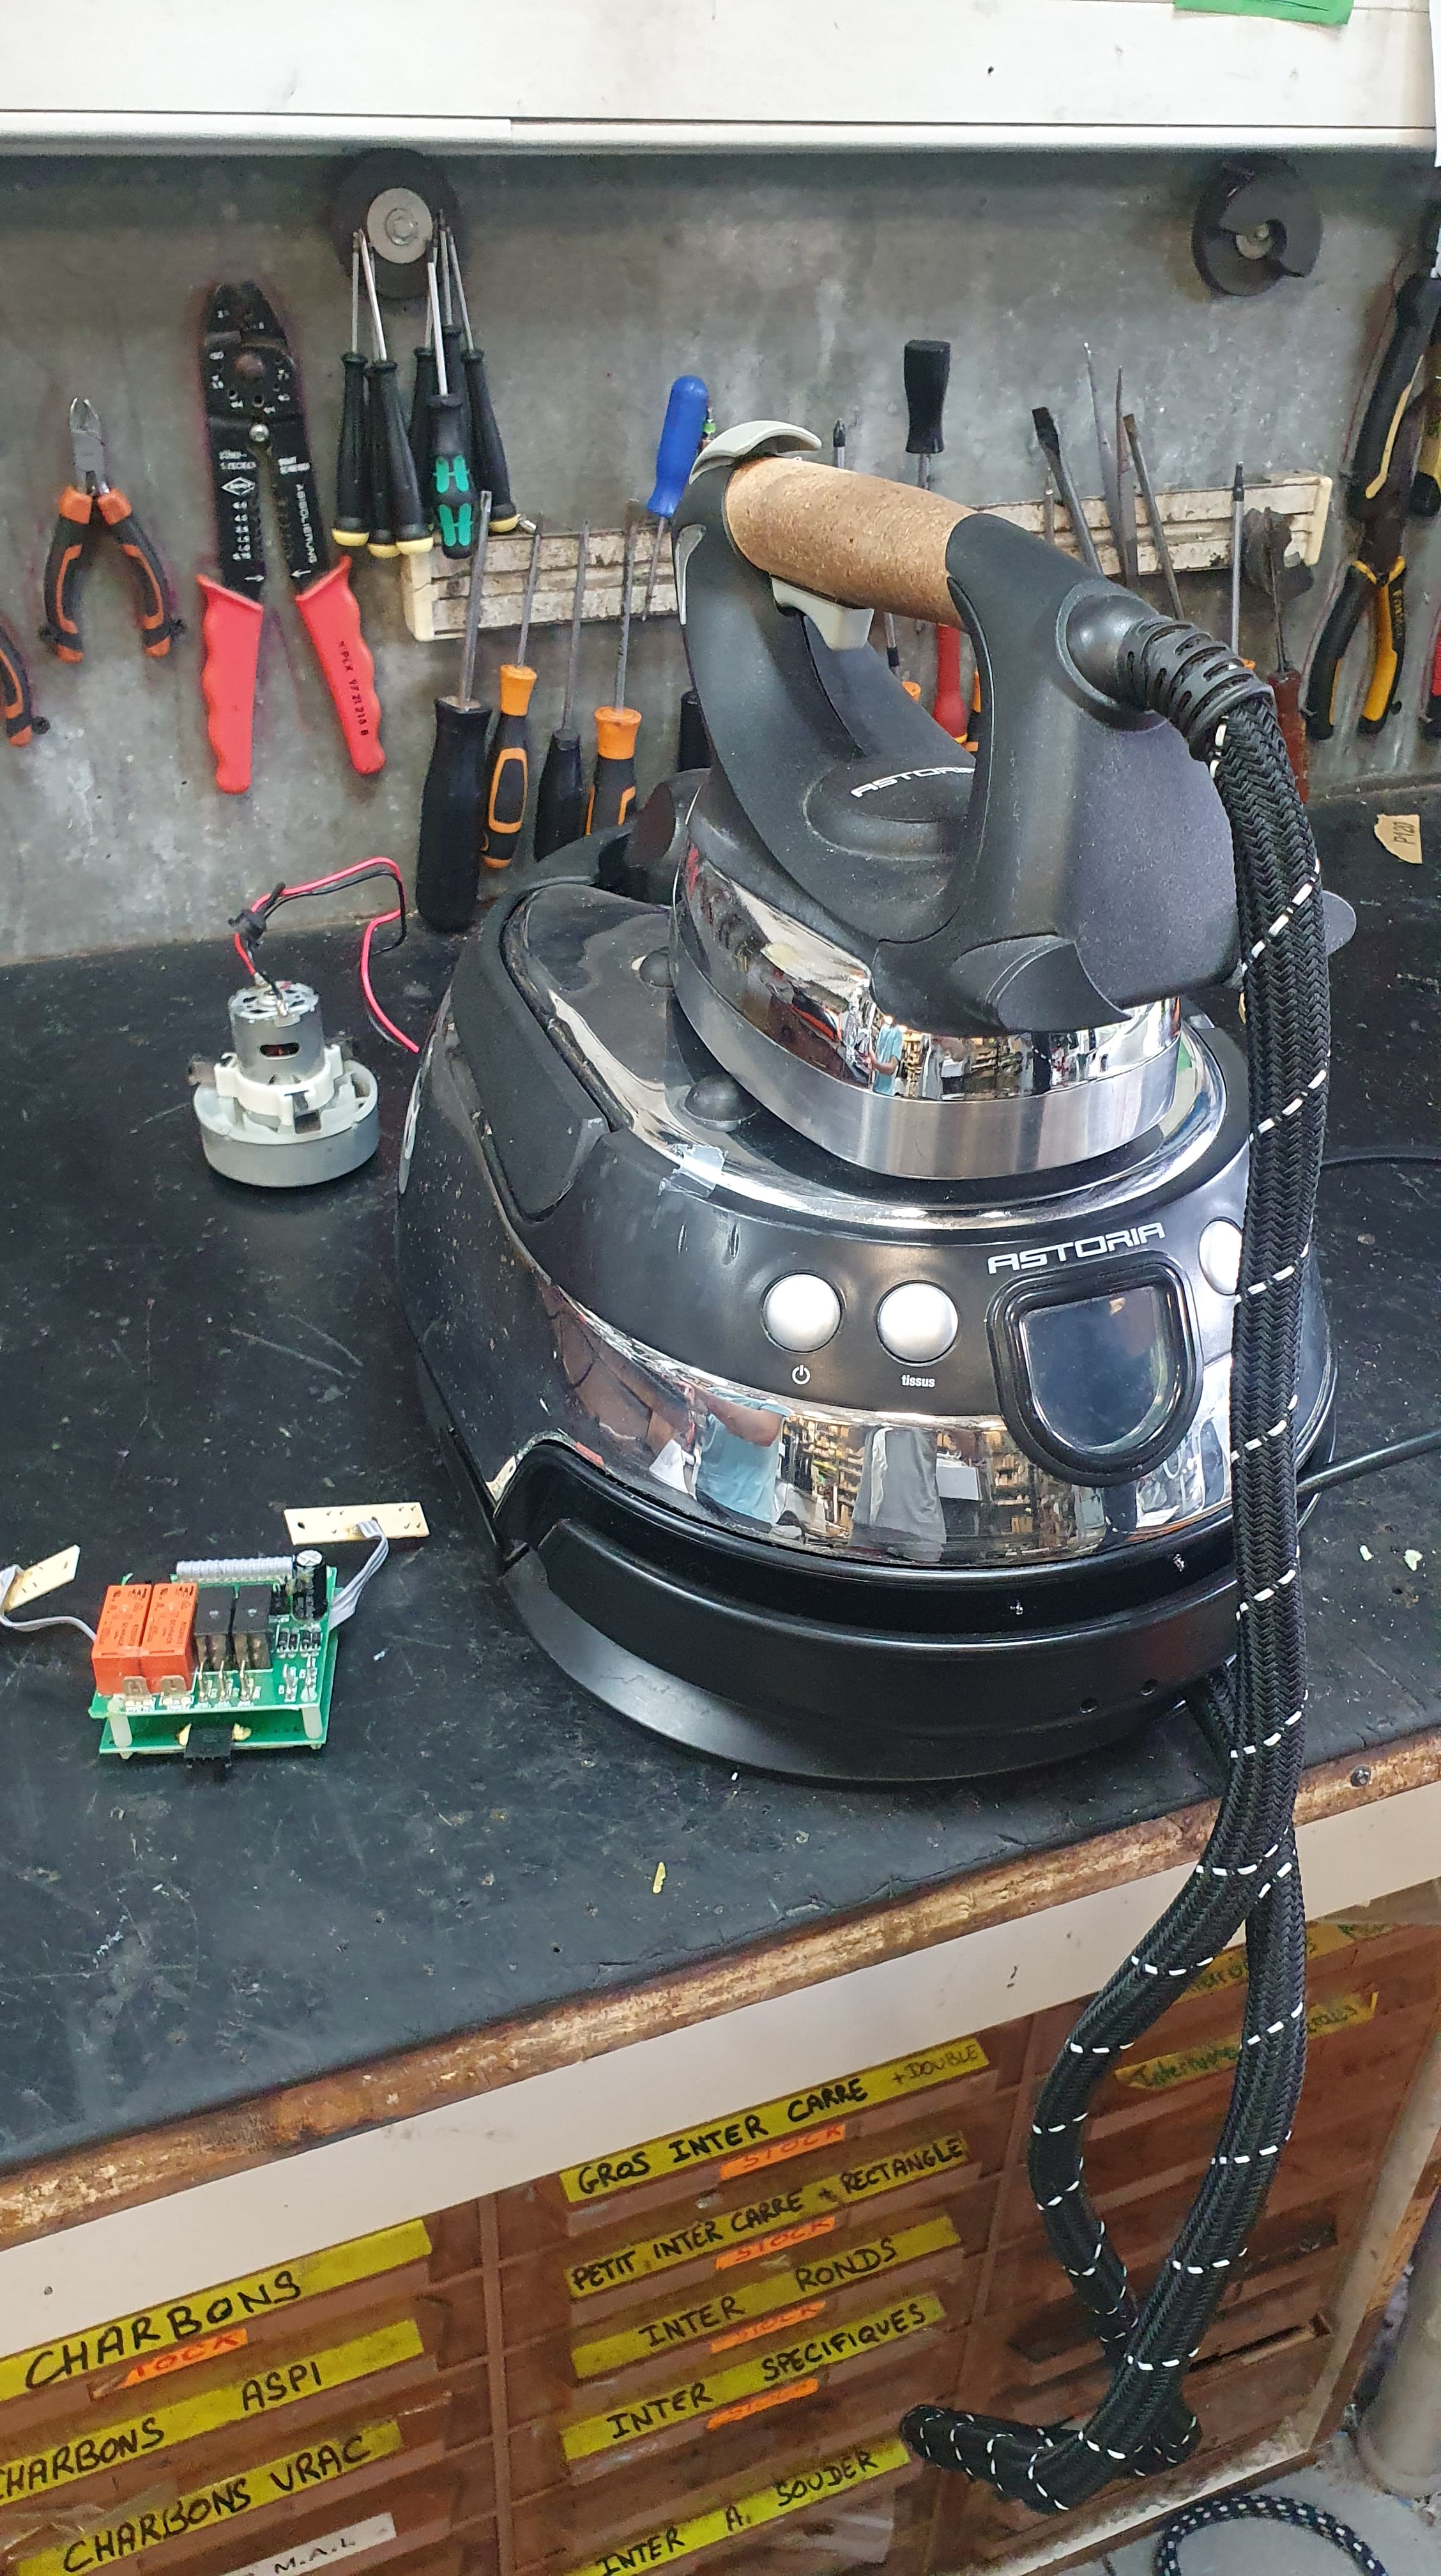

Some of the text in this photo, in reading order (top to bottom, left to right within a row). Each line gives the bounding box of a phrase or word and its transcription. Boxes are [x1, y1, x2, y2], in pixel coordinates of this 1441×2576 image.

[987, 1222, 1166, 1275] ASTORIA
[901, 1374, 936, 1388] tissus
[577, 2150, 652, 2195] GROS
[668, 2115, 769, 2164] INTER
[786, 2078, 869, 2122] CARRE
[572, 2250, 636, 2291] PETIT
[652, 2220, 724, 2260] INTER
[730, 2188, 805, 2233] CARRE
[840, 2137, 964, 2195] RECTANGLE
[24, 2270, 301, 2391] CHARBONS
[638, 2236, 899, 2347] INTER RONDS
[241, 2360, 322, 2412] ASPI
[606, 2302, 926, 2440] INTER SPECIFIQUES
[63, 2434, 371, 2573] CHARBONS VRAC
[595, 2527, 685, 2576] INTER
[775, 2449, 878, 2508] SOUDER
